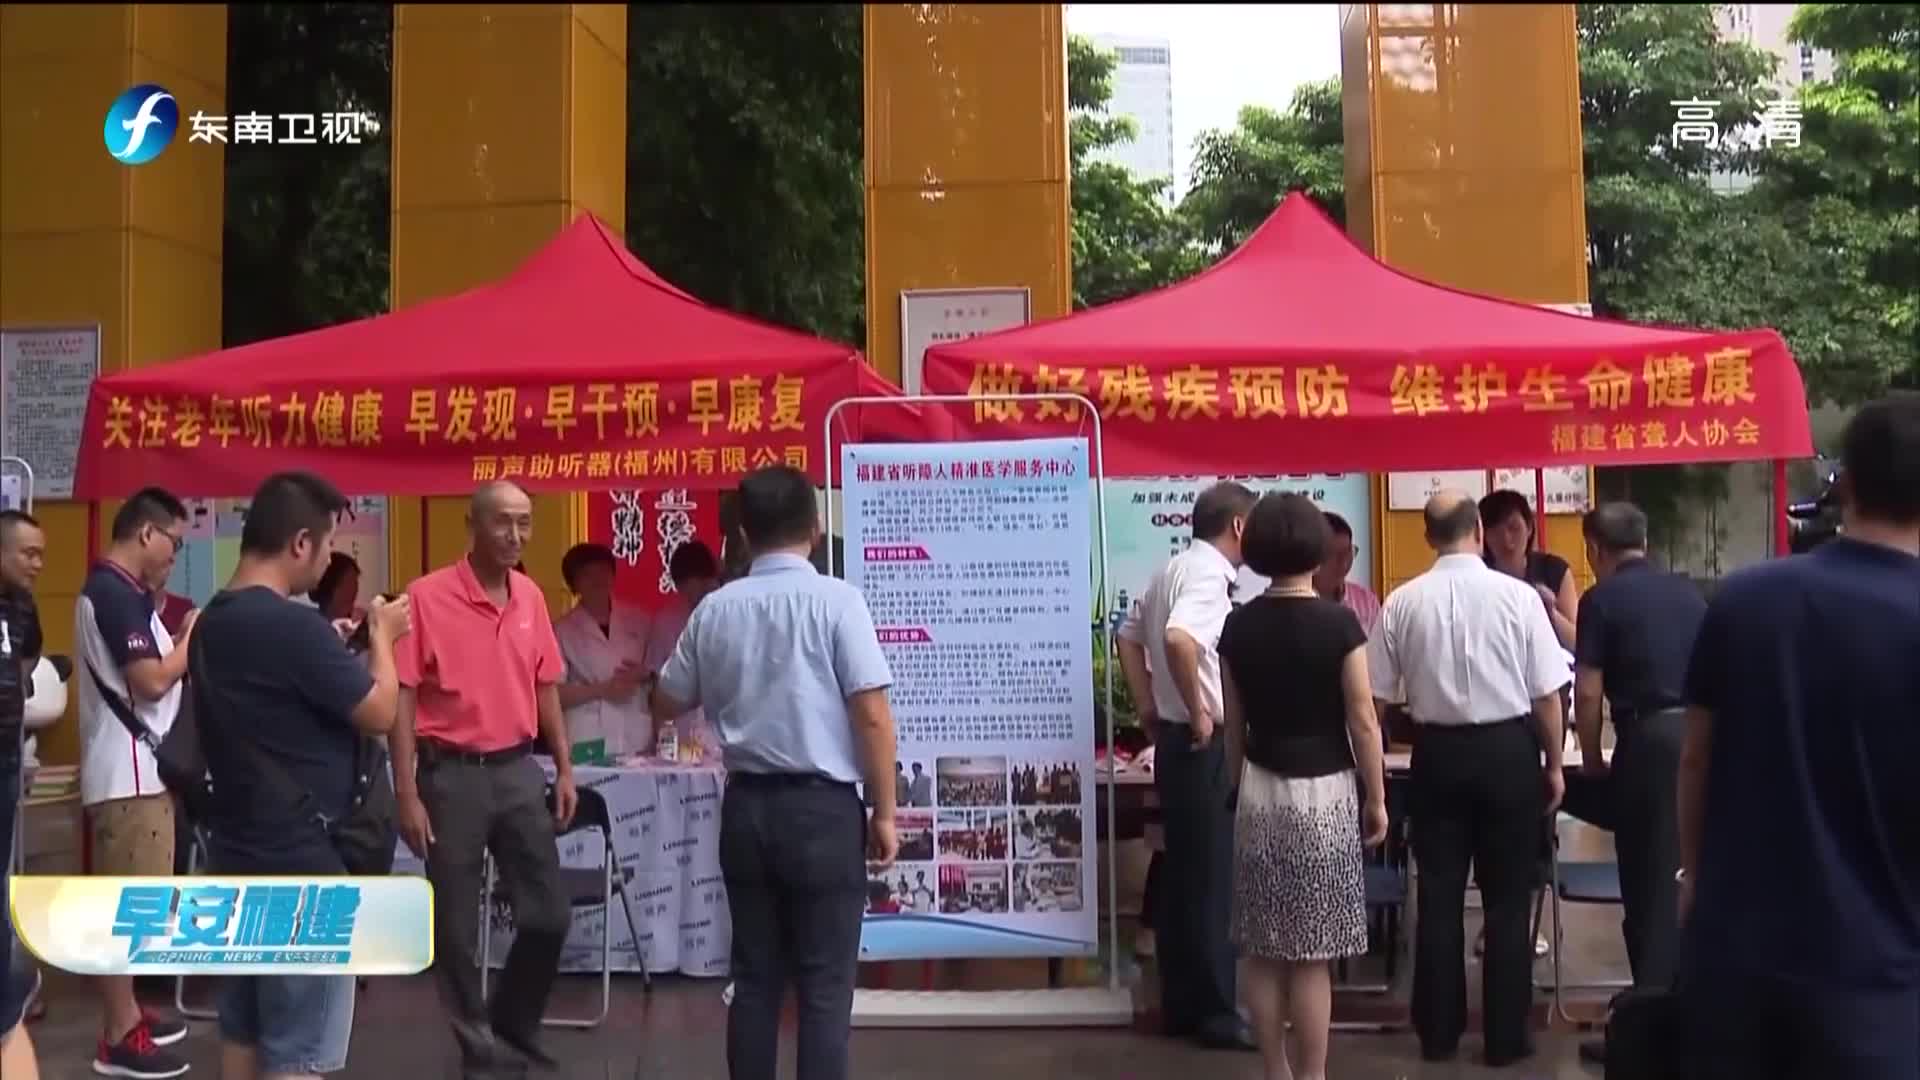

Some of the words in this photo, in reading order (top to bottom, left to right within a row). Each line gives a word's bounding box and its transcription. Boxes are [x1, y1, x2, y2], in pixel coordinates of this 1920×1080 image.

[967, 364, 1350, 424] 做好残疾预防
[1389, 346, 1756, 417] 维护生命健康
[103, 388, 383, 449] 关注老年听力健康
[405, 374, 806, 446] 早发现·早干预·早康复
[1552, 417, 1759, 453] 福建省聋人协会
[472, 446, 809, 481] 丽声助听器(福州)有限公司
[856, 459, 1075, 482] 福建省听障人精准医学服务中心
